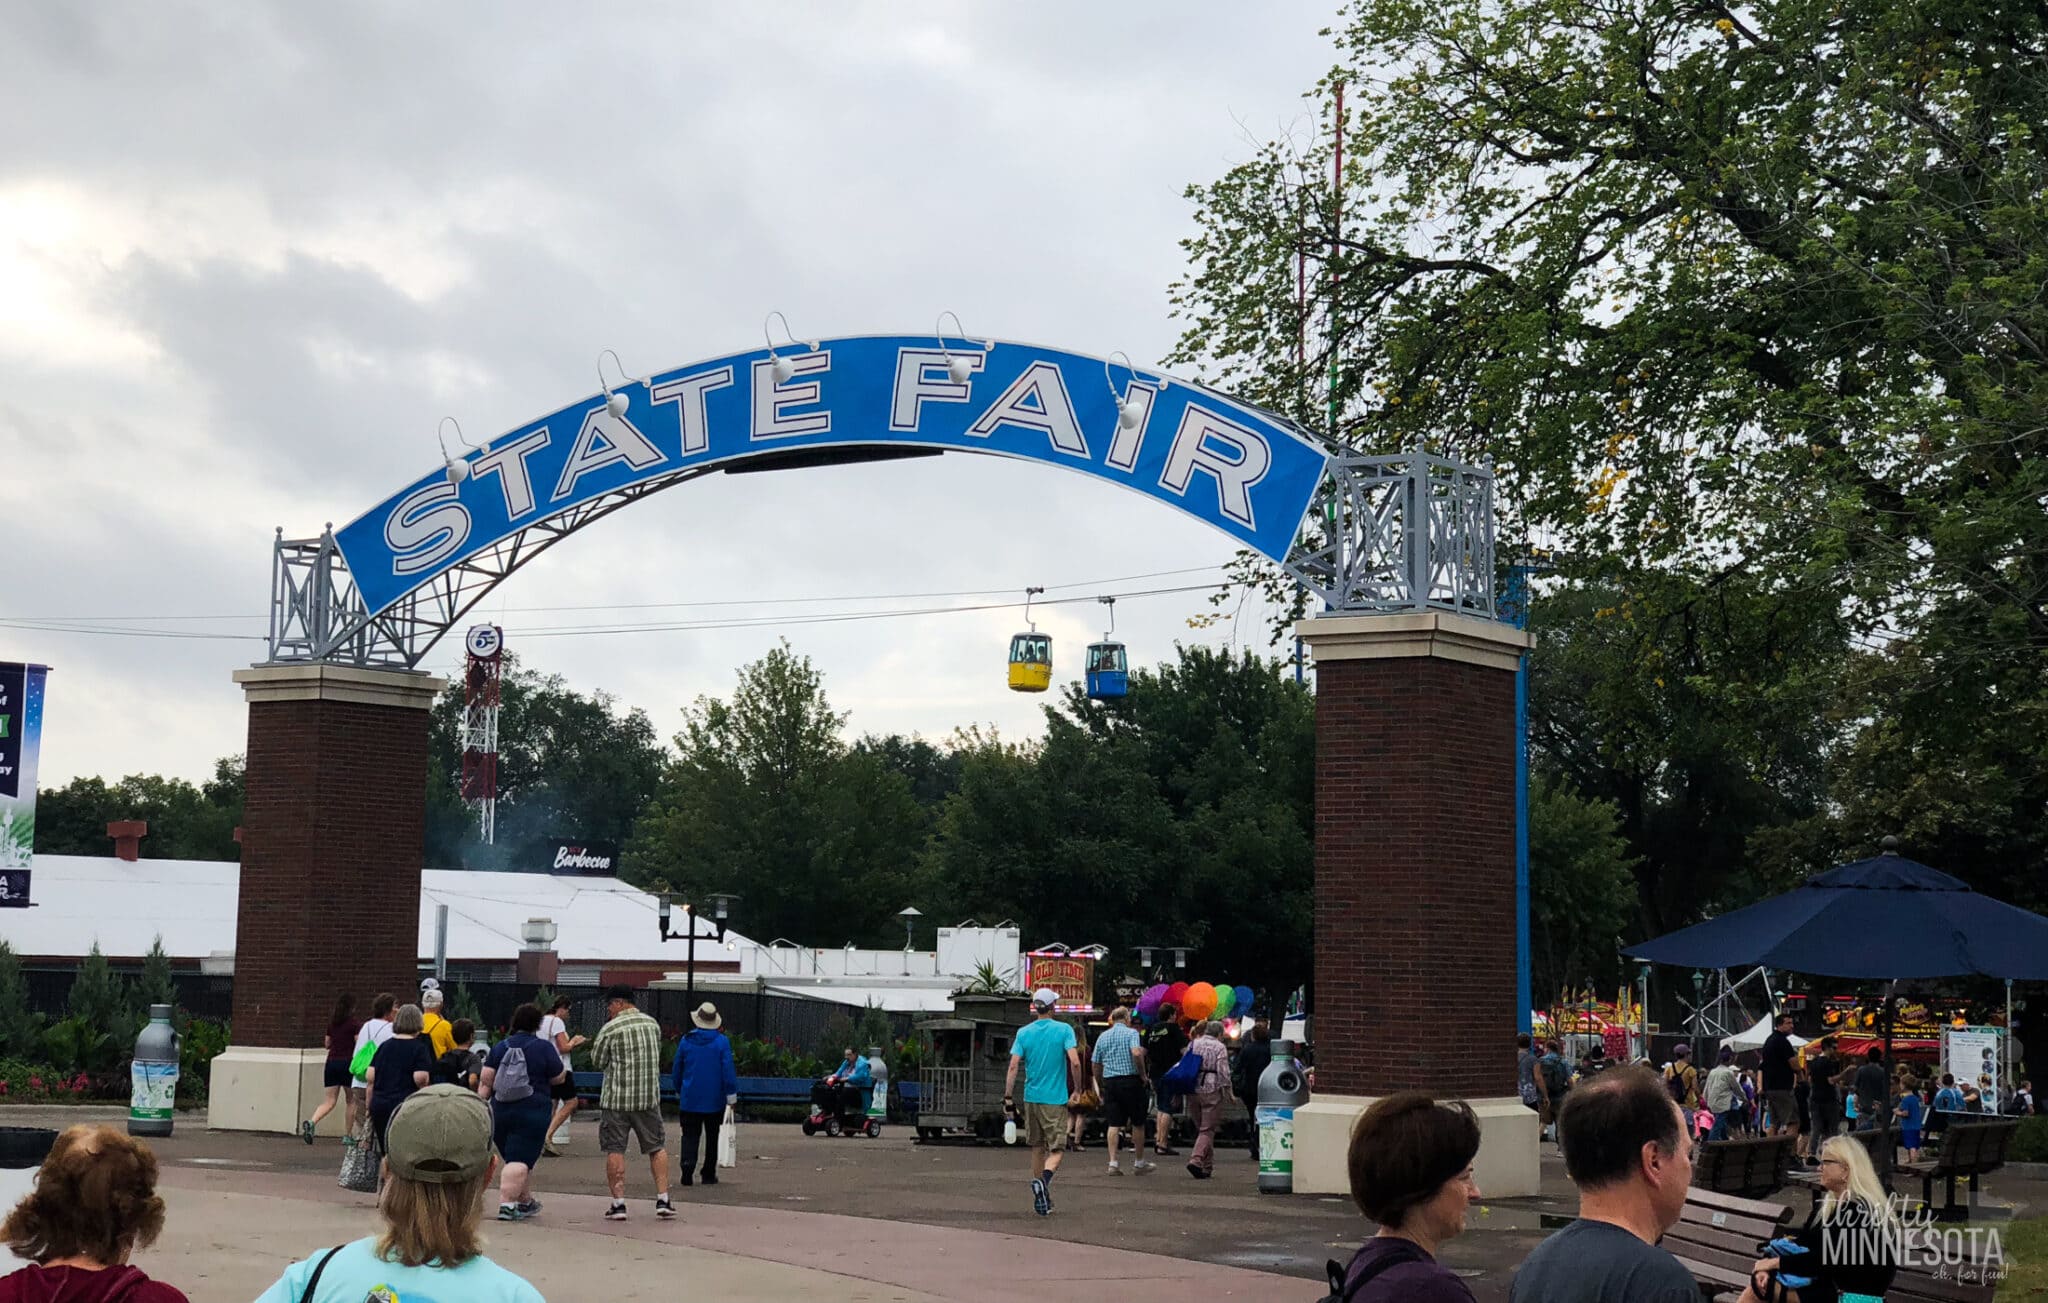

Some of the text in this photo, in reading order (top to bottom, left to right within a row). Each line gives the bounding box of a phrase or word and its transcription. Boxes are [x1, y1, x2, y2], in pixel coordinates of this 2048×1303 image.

[384, 346, 1272, 576] STATE FAIR
[553, 846, 611, 869] Barbecue
[1035, 960, 1085, 982] OLD TIME
